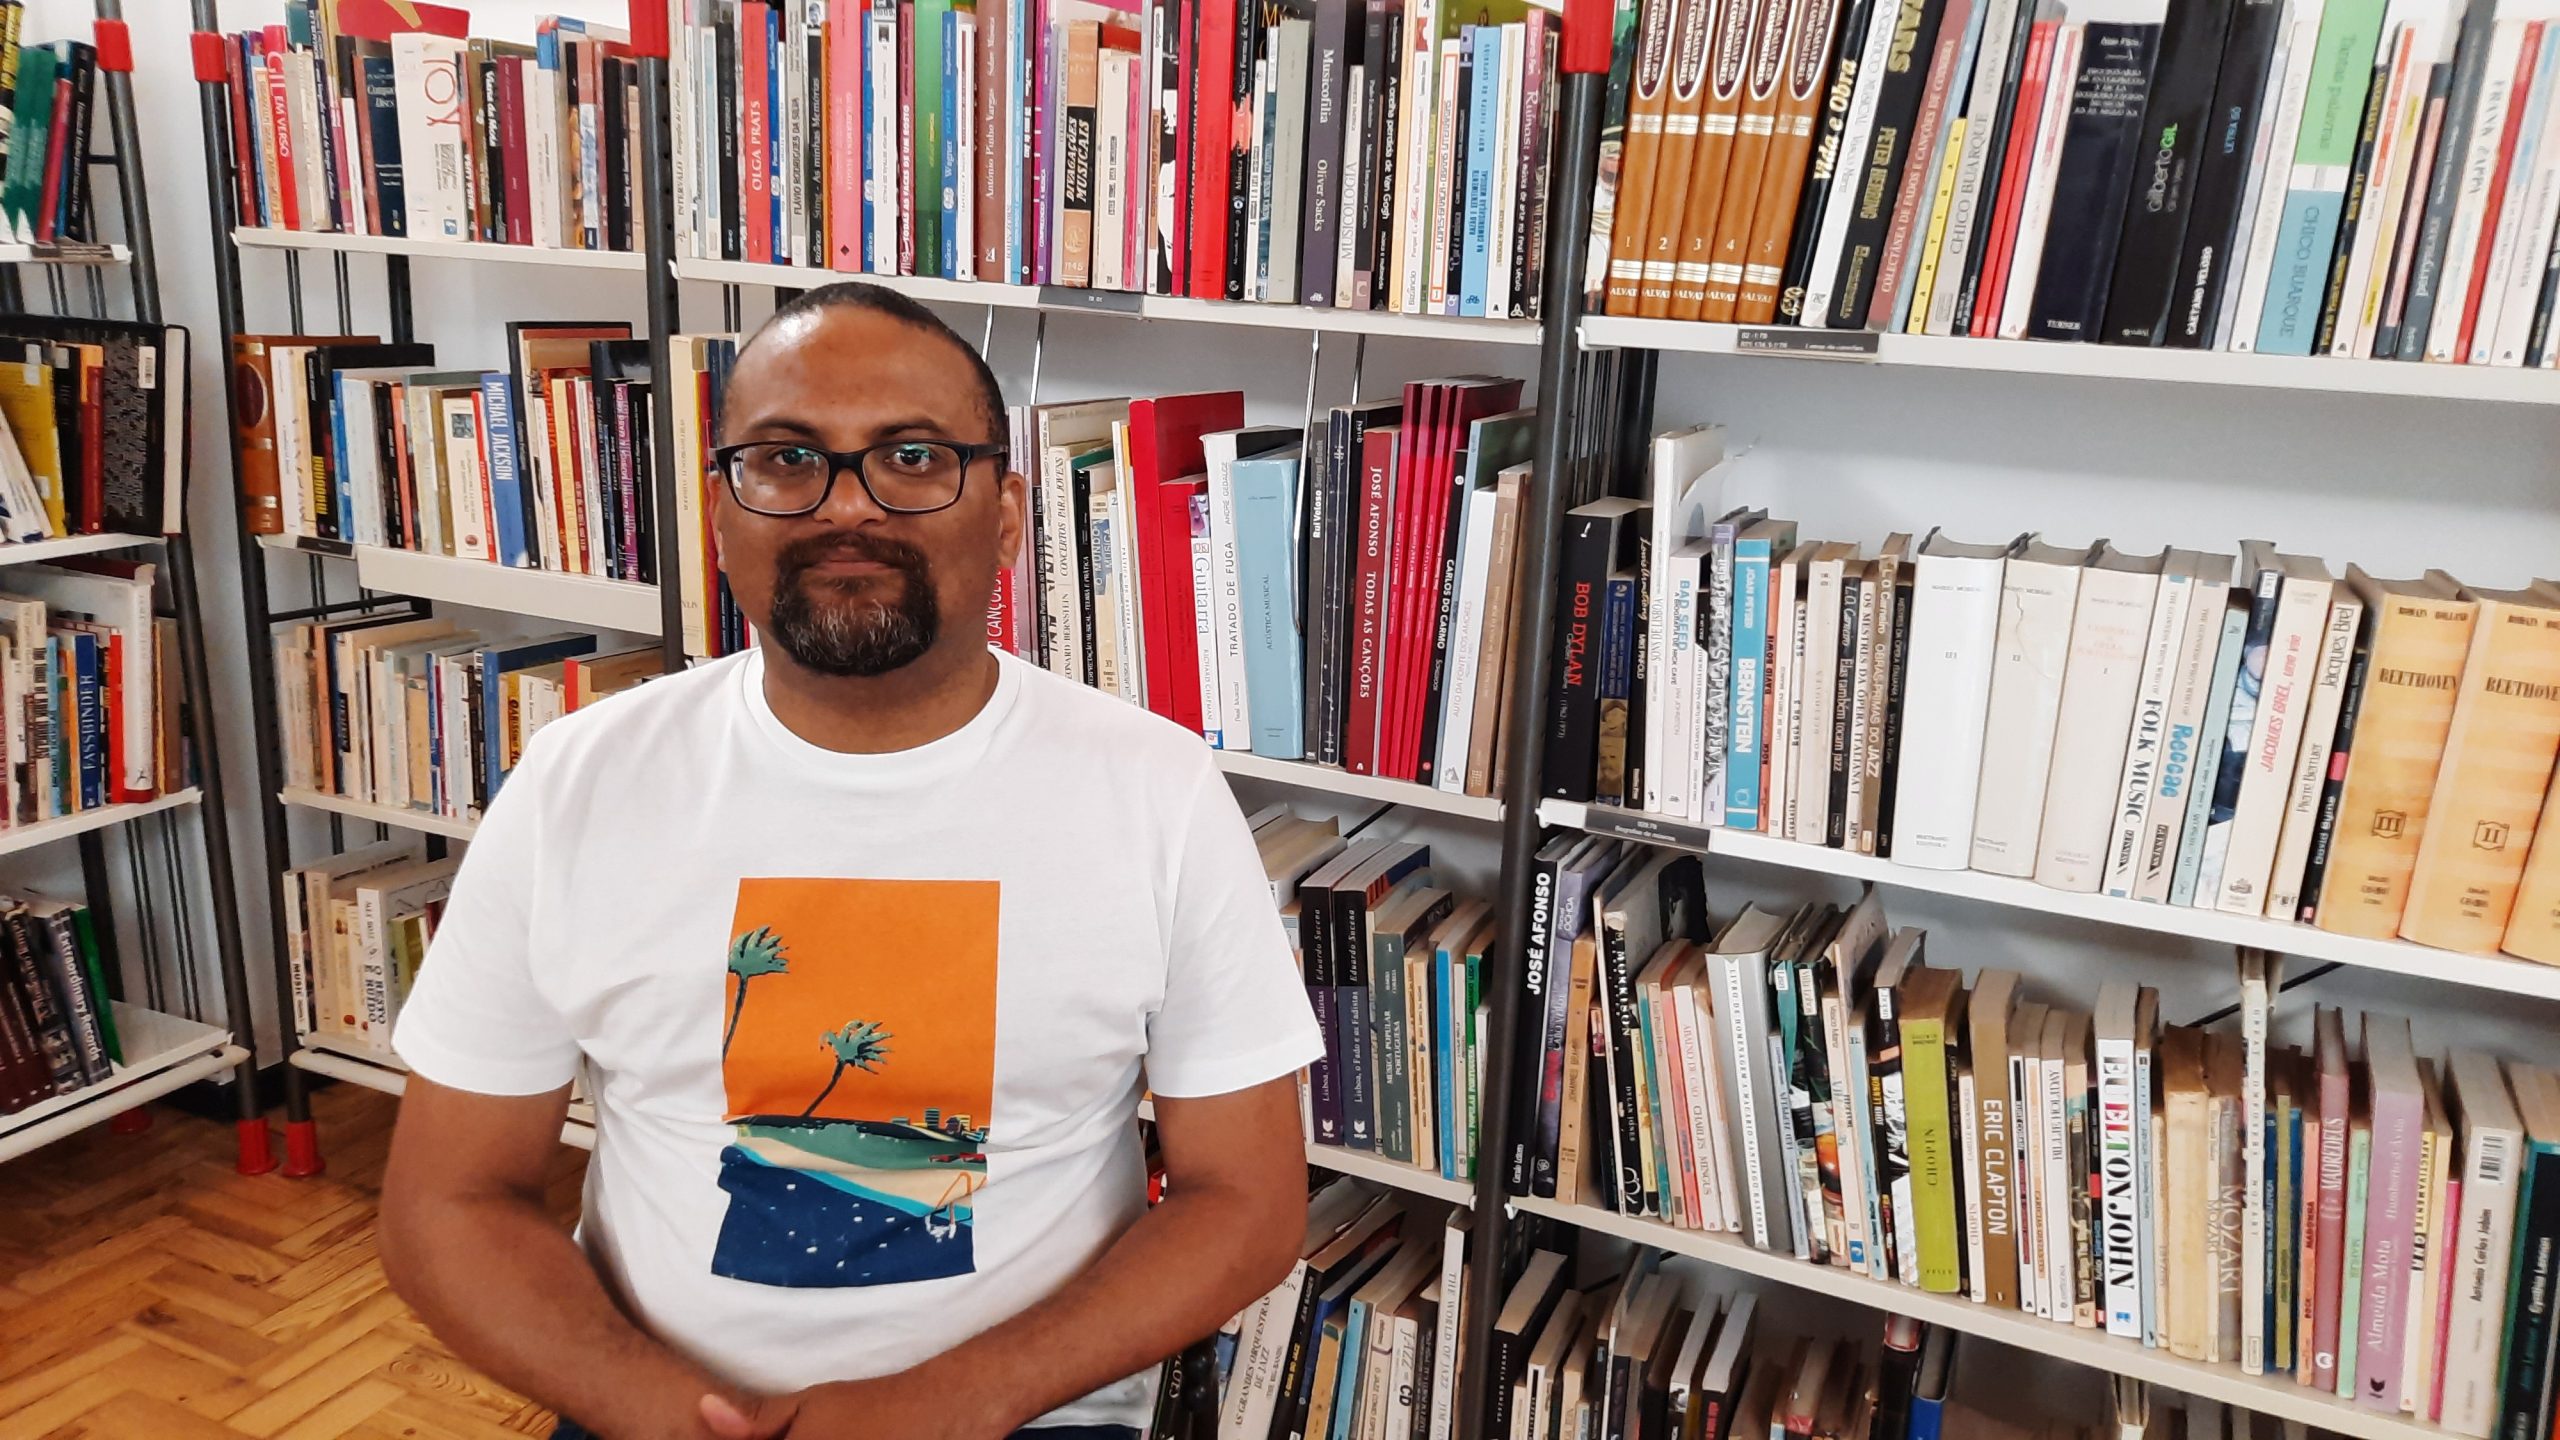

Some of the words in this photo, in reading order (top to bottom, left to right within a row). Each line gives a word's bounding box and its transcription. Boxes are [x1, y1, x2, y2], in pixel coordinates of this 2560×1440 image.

[1319, 49, 1334, 123] Musicofilia
[1828, 58, 1857, 112] Obra
[276, 118, 289, 158] VERSO
[750, 100, 762, 145] PRATS
[984, 124, 995, 155] Pinho
[1827, 117, 1841, 131] e
[752, 149, 762, 190] OLGA
[1065, 117, 1078, 203] DIVAGAÇÕES
[1076, 119, 1089, 203] MUSICAIS
[1812, 135, 1837, 180] Vida
[1956, 112, 1989, 194] BUARQUE
[984, 159, 995, 199] António
[1315, 160, 1328, 197] Oliver
[1383, 174, 1392, 192] Van
[1314, 198, 1326, 232] Sacks
[1341, 161, 1357, 260] MUSICOLOGIA
[1379, 194, 1391, 220] Gogh
[1899, 208, 1912, 223] DE
[1949, 199, 1972, 255] CHICO
[1659, 237, 1668, 251] 2
[1693, 238, 1702, 251] 3
[1726, 238, 1736, 251] 4
[2297, 206, 2320, 261] CHICO
[1609, 287, 1638, 297] ALVAT
[486, 381, 509, 429] MICHAEL
[491, 432, 514, 481] JACKSON
[1369, 466, 1384, 499] JOSÉ
[1055, 495, 1067, 518] PARA
[1057, 522, 1069, 577] CONCERTOS
[1367, 503, 1381, 557] AFONSO
[1224, 541, 1235, 575] FUGA
[1443, 559, 1456, 595] CARLOS
[1193, 556, 1212, 635] Guitarra
[1226, 580, 1236, 596] DE
[1262, 573, 1272, 610] MUSICAL
[1363, 570, 1377, 615] TODAS
[1573, 581, 1590, 617] BOB
[1679, 580, 1691, 610] BAD
[1744, 567, 1756, 597] JOAN
[1441, 598, 1452, 611] DO
[1227, 602, 1239, 657] TRATADO
[1363, 618, 1373, 634] AS
[1437, 614, 1450, 649] CARMO
[1678, 614, 1690, 652] SEED
[1358, 637, 1374, 698] CANÇÕES
[1568, 622, 1587, 686] DYLAN
[1840, 658, 1853, 677] Elas
[2320, 630, 2349, 690] Jacques
[2335, 605, 2354, 631] Brel
[2378, 667, 2458, 691] BEETHOVEN
[1734, 657, 1756, 753] BERNSTEIN
[1836, 679, 1851, 721] também
[1835, 722, 1847, 751] tocam
[1868, 726, 1880, 743] DO
[2137, 699, 2164, 753] FOLK
[2259, 717, 2283, 773] JACQUES
[1831, 752, 1846, 772] jazz
[1866, 744, 1879, 778] JAZZ
[2123, 759, 2151, 825] MUSIC
[2484, 827, 2499, 843] II
[1531, 873, 1552, 944] AFONSO
[1526, 947, 1544, 996] JOSÉ
[58, 930, 89, 1014] Extraordinary
[80, 1014, 102, 1062] Records
[1383, 1010, 1393, 1050] POPULAR
[1392, 1021, 1403, 1076] PORTUGUESA
[1383, 1052, 1394, 1085] MÚSICA
[1983, 1098, 2004, 1141] ERIC
[1924, 1127, 1938, 1187] CHOPIN
[2105, 1101, 2133, 1200] ELTON
[2320, 1118, 2344, 1192] MADREDEUS
[1985, 1148, 2008, 1235] CLAPTON
[2220, 1184, 2241, 1296] MOZART
[2475, 1208, 2491, 1236] Jobim
[2106, 1202, 2135, 1290] JOHN
